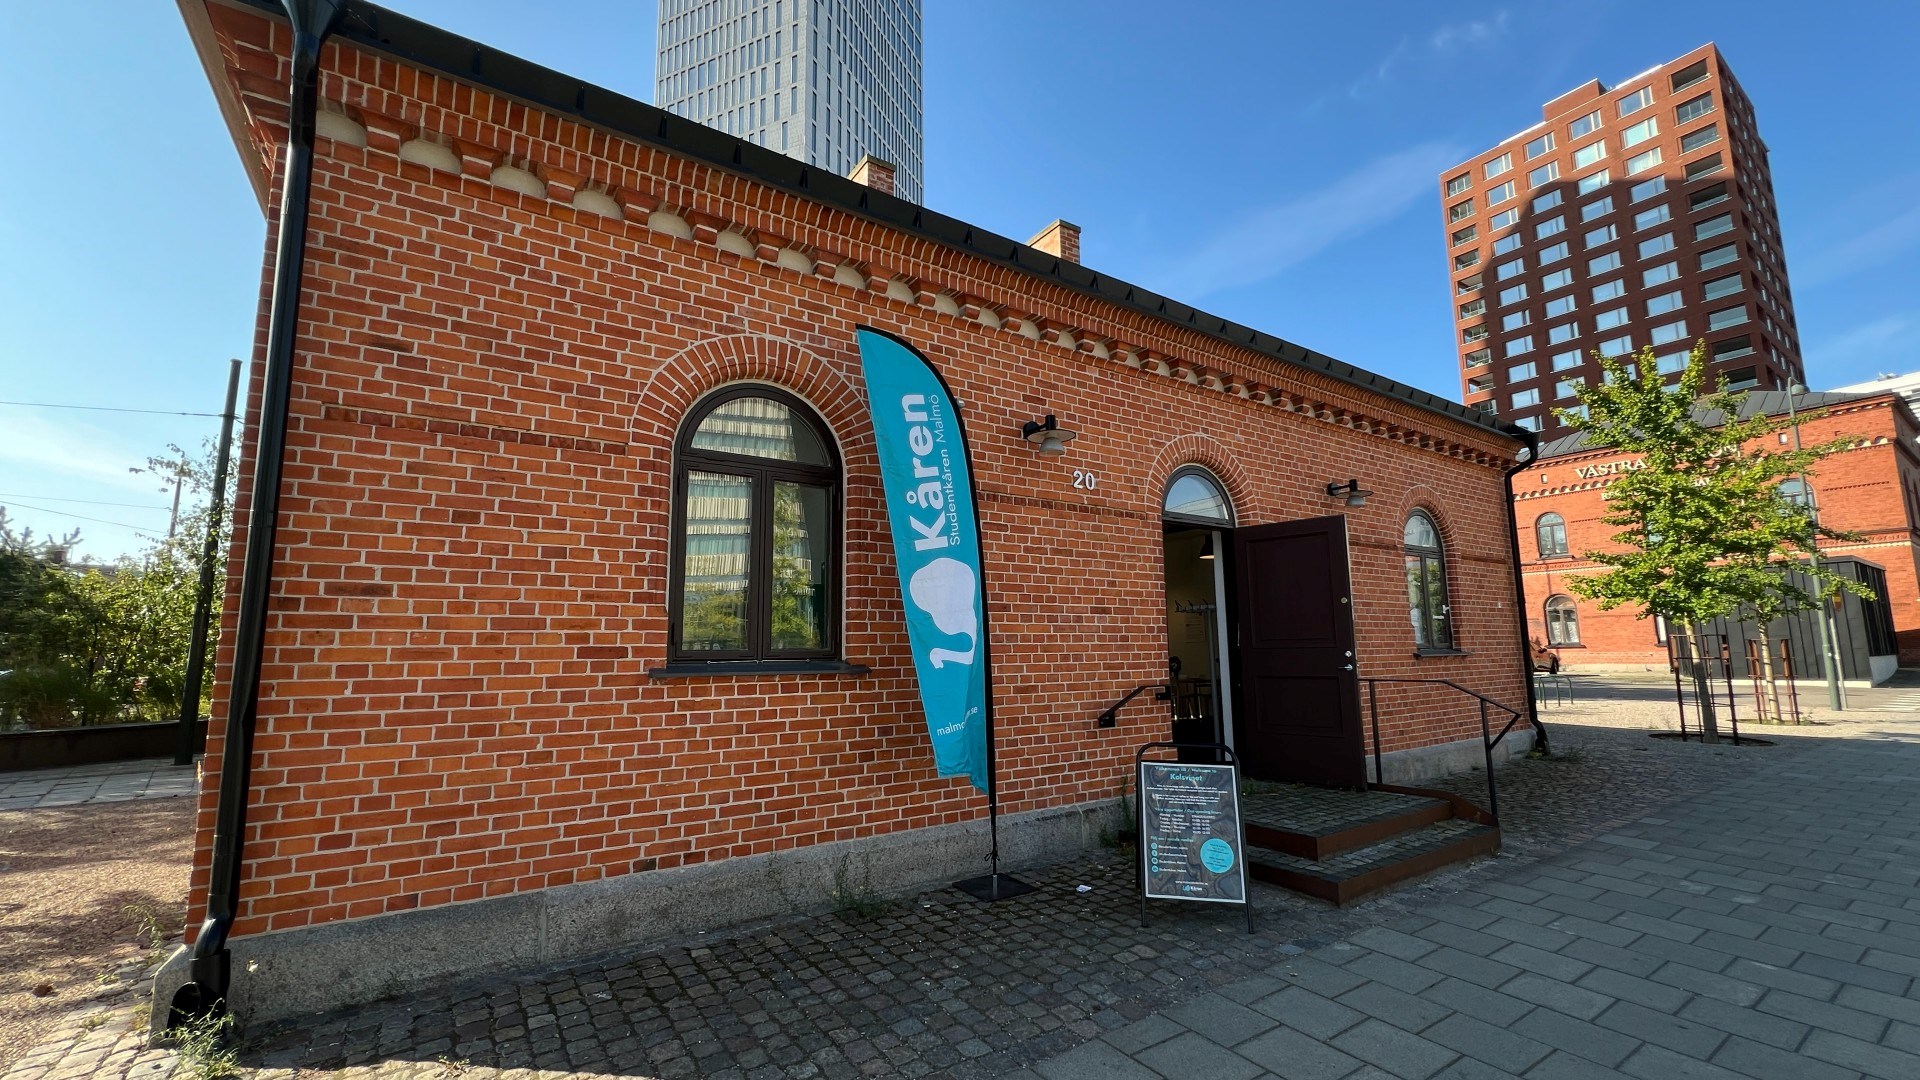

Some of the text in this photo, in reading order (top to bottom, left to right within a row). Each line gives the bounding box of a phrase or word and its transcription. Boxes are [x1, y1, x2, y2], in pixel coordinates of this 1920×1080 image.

[902, 394, 949, 552] Kåren
[929, 394, 961, 546] Studentkåren Malmö
[1073, 470, 1095, 490] 20
[1574, 457, 1648, 480] VÄSTRA
